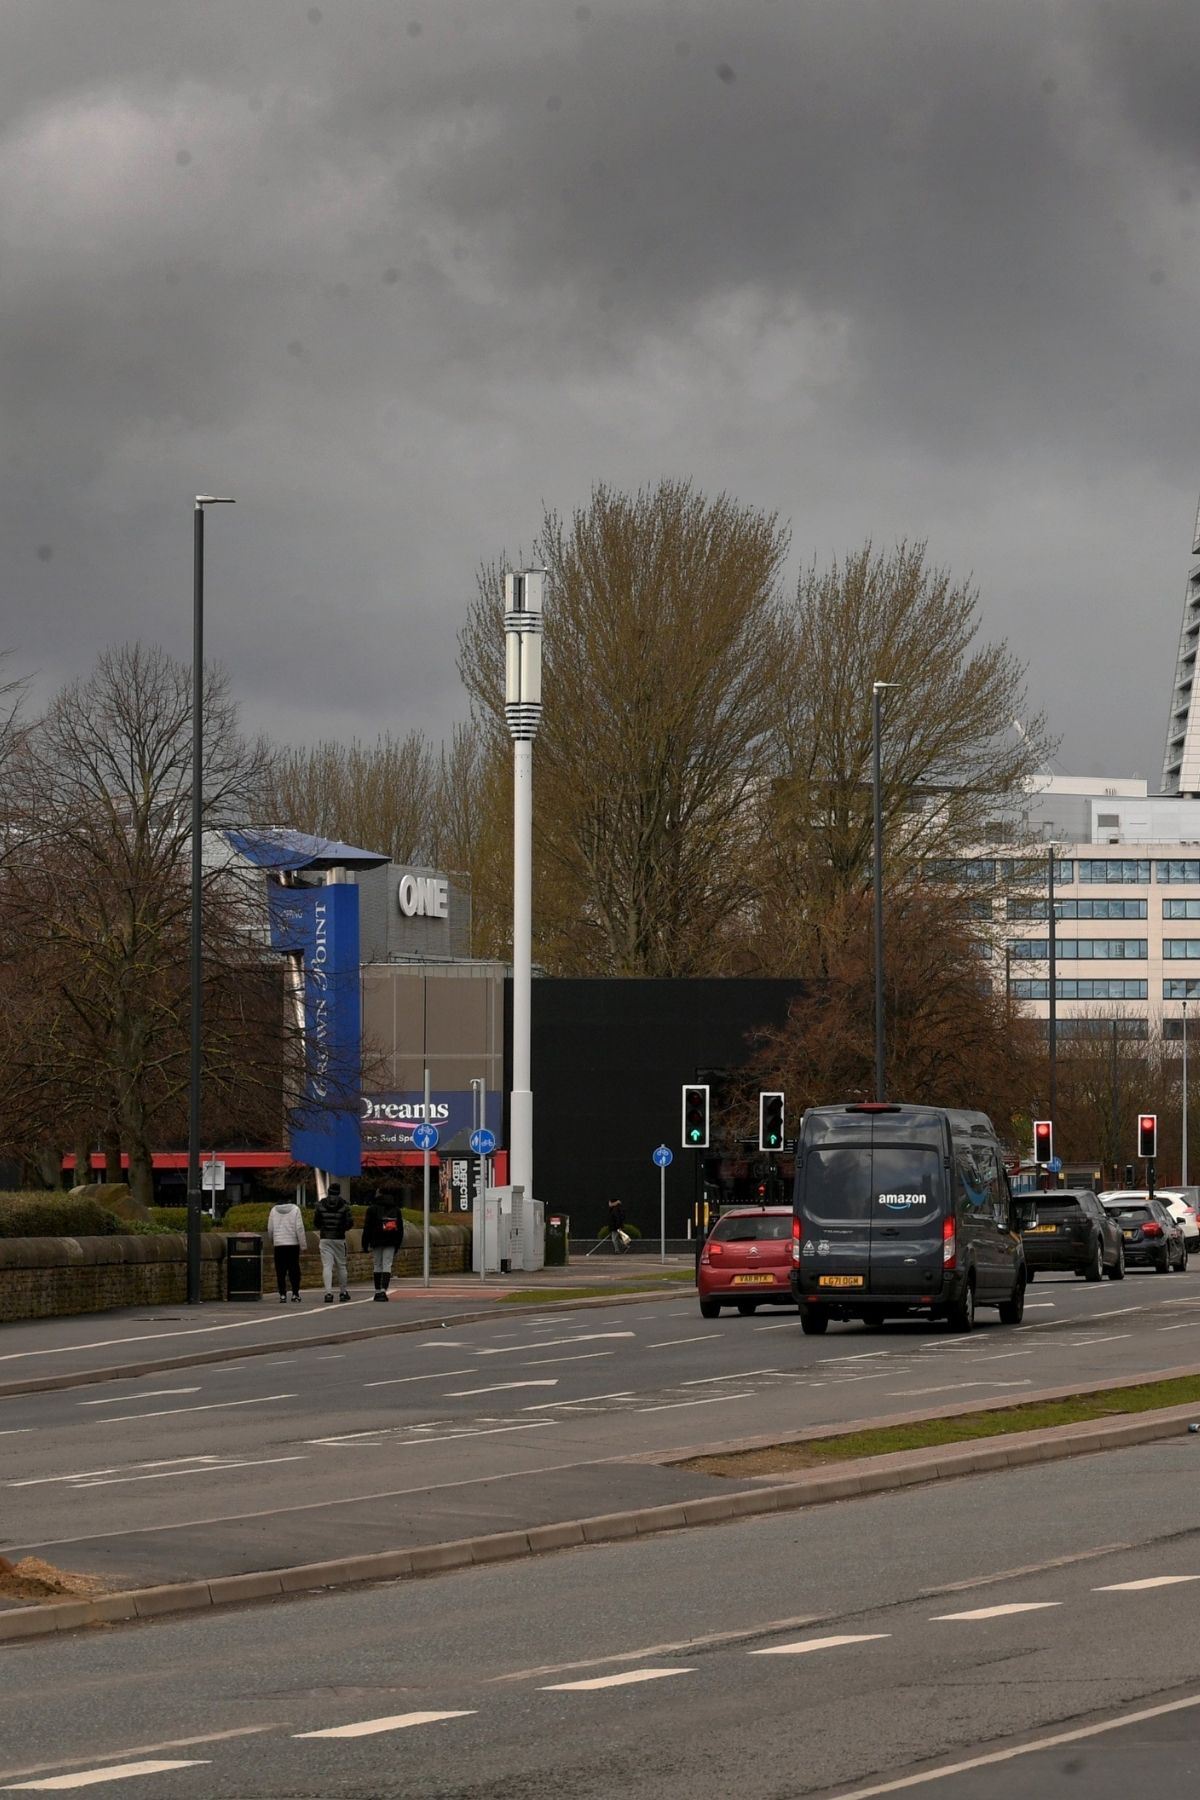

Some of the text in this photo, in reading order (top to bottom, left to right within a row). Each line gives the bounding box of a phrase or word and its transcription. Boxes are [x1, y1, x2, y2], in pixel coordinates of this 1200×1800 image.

[399, 874, 449, 918] ONE
[311, 901, 328, 991] POINT
[452, 1160, 460, 1187] LEEDS
[460, 1167, 468, 1210] DEFECTED
[878, 1194, 927, 1204] amazon
